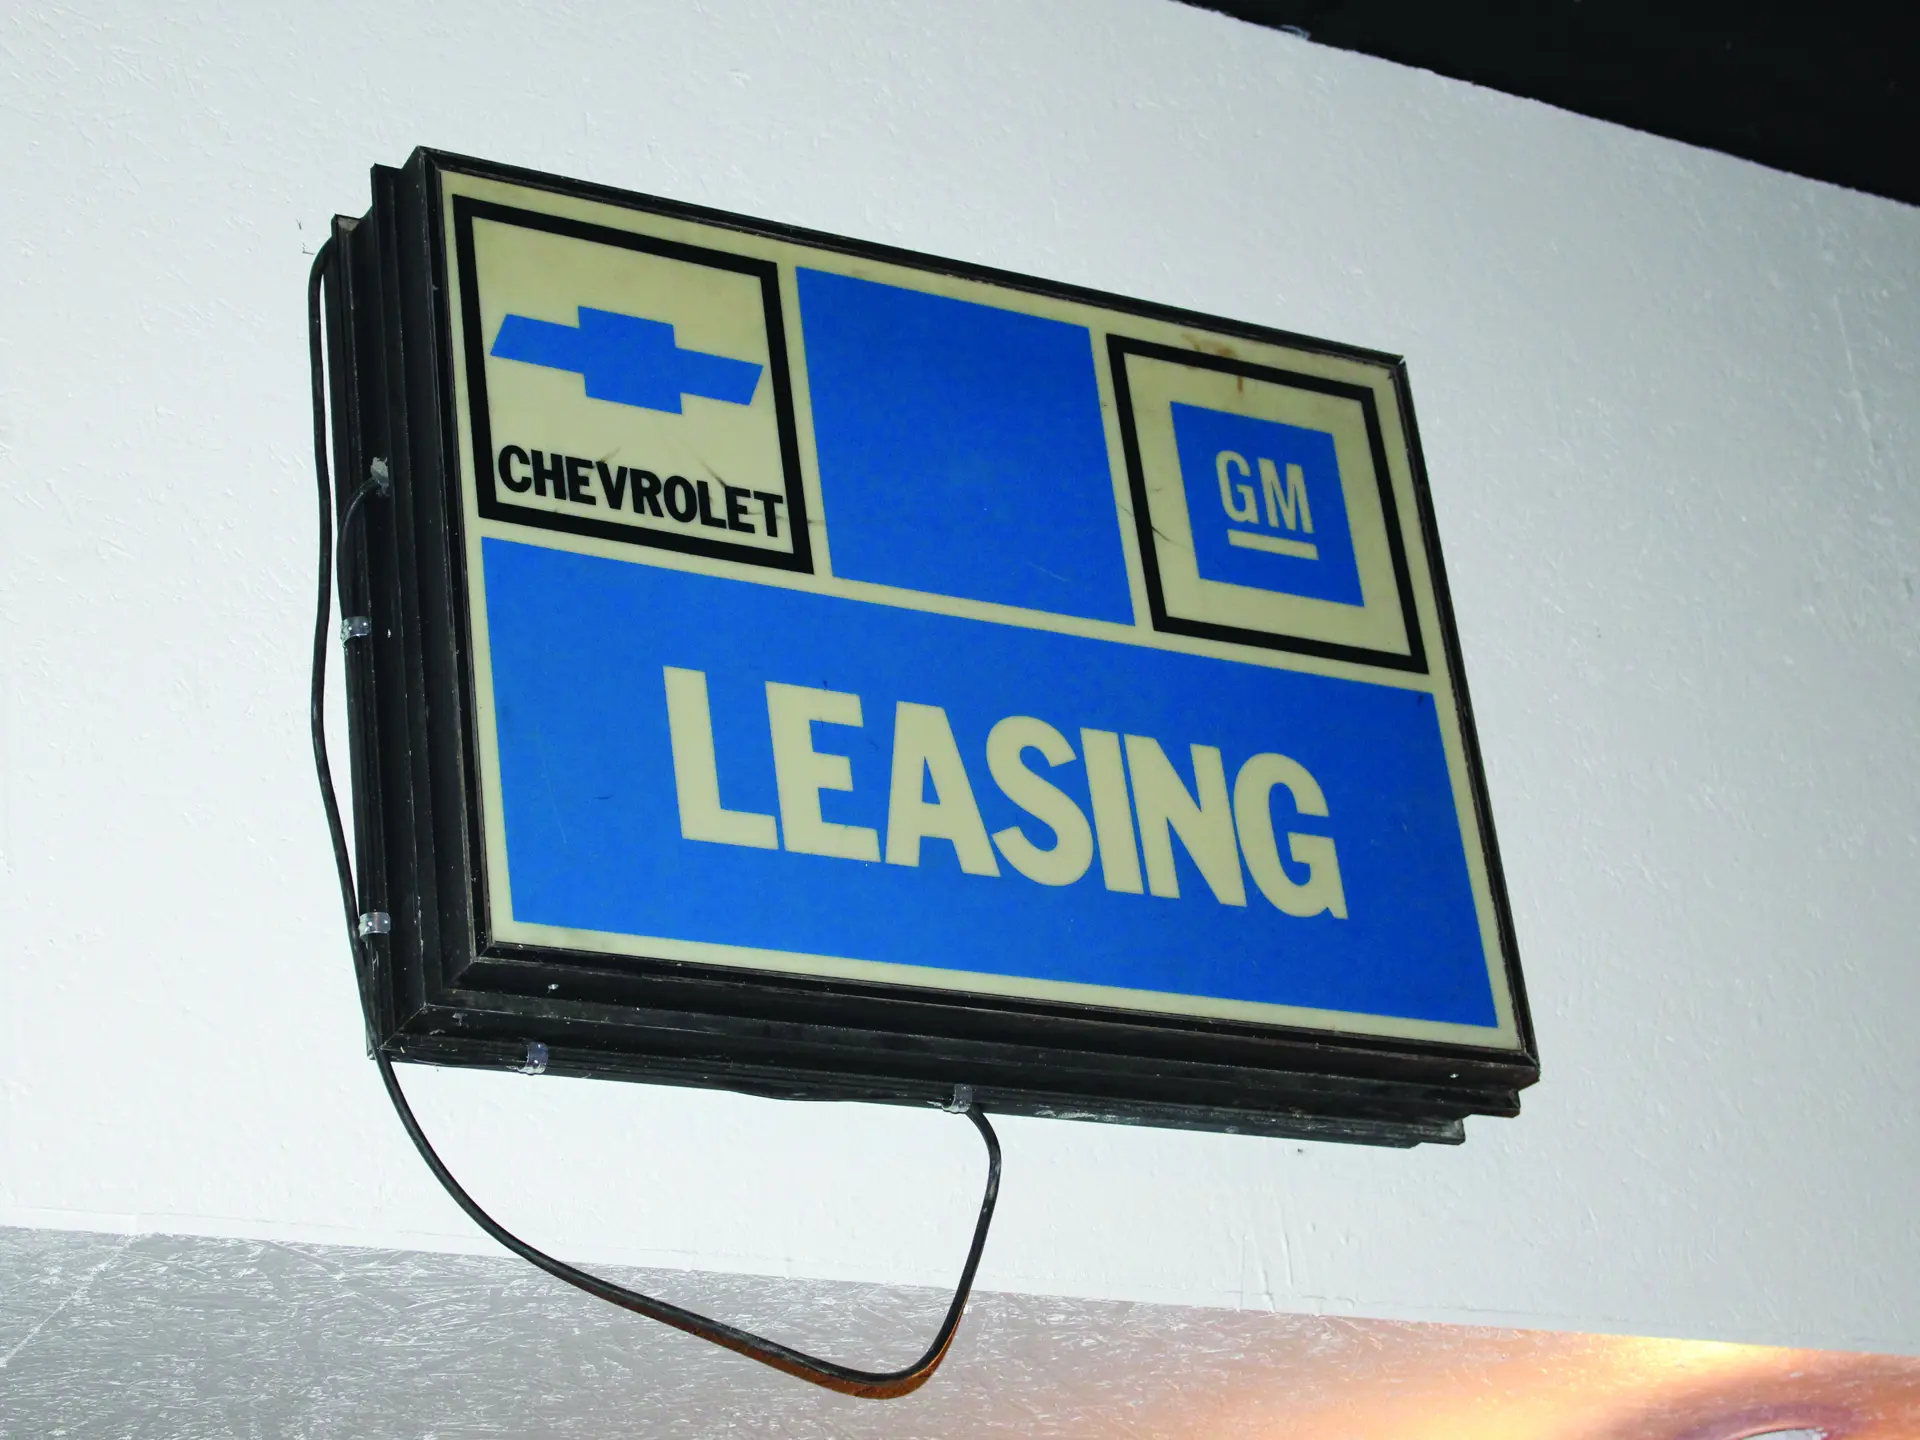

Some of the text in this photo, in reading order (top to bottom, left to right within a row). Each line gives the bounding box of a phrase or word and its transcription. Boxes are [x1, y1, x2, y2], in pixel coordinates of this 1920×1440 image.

[498, 445, 783, 537] CHEVROLET
[1215, 450, 1314, 534] GM
[663, 666, 1348, 920] LEASING
